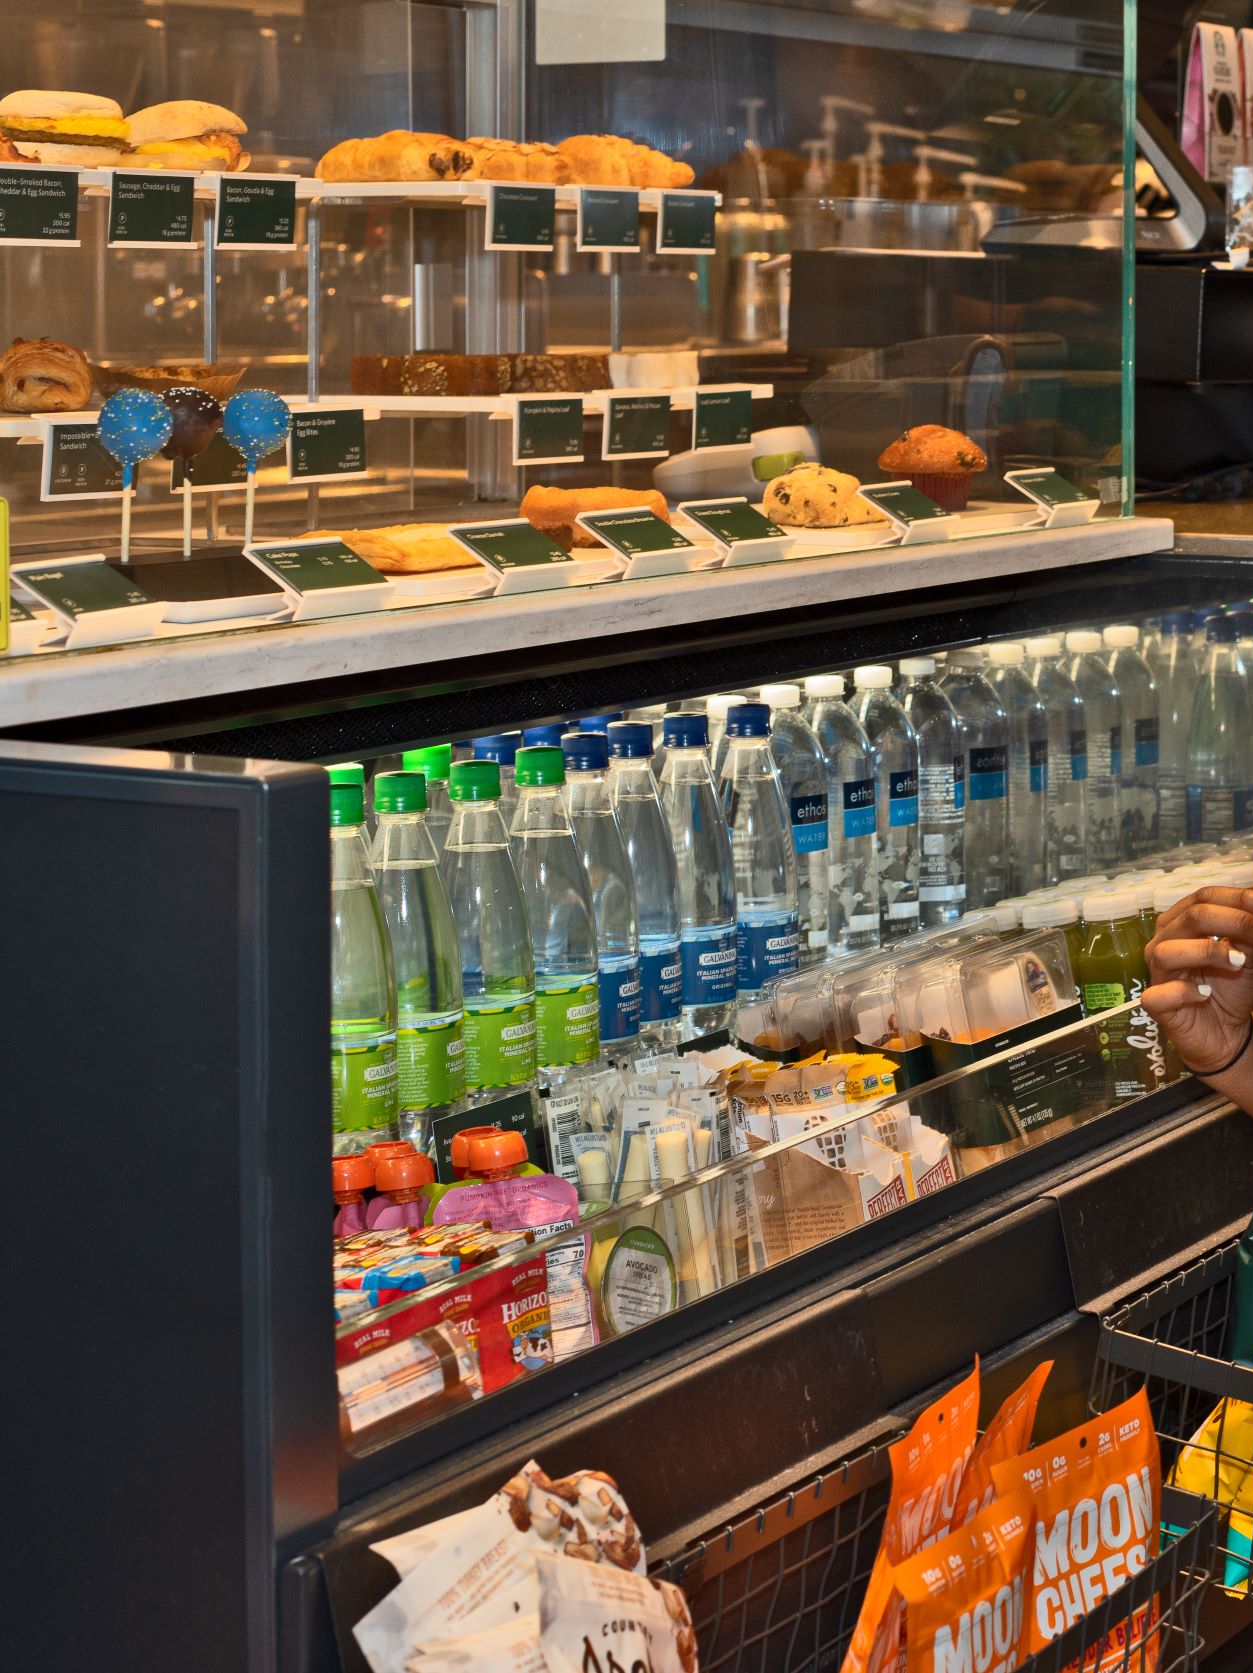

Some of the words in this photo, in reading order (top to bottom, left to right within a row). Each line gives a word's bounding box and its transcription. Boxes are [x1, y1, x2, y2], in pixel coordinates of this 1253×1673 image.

[0, 178, 43, 187] ouble-Smoked
[142, 183, 166, 191] Cheddar
[171, 184, 181, 193] Egg
[28, 188, 37, 198] Egg
[38, 189, 66, 197] Sandwich
[118, 191, 145, 199] Sandwich
[896, 777, 918, 792] etho
[797, 802, 827, 818] ethos
[771, 934, 798, 949] GALVAN
[697, 969, 720, 977] ITALIAN
[702, 973, 725, 981] MINERAL
[570, 1002, 598, 1018] GALVAN
[505, 1022, 536, 1038] GALVAN
[564, 1022, 587, 1032] ITALIAN
[500, 1042, 523, 1053] ITALIAN
[368, 1062, 398, 1079] GALVAN
[917, 1162, 945, 1197] PERFECT
[460, 1191, 491, 1202] PUMPKIN
[868, 1188, 897, 1218] PERFECT
[550, 1221, 572, 1235] Facts
[573, 1249, 584, 1260] 70
[528, 1268, 545, 1277] MILK
[625, 1259, 658, 1274] AVOCADO
[454, 1294, 472, 1303] MILK
[501, 1291, 548, 1325] HORIZO
[512, 1309, 550, 1333] ORGANI
[372, 1329, 391, 1339] MILK
[1119, 1418, 1140, 1434] KETO
[1034, 1466, 1152, 1587] MOON
[1036, 1540, 1151, 1640] CHEES
